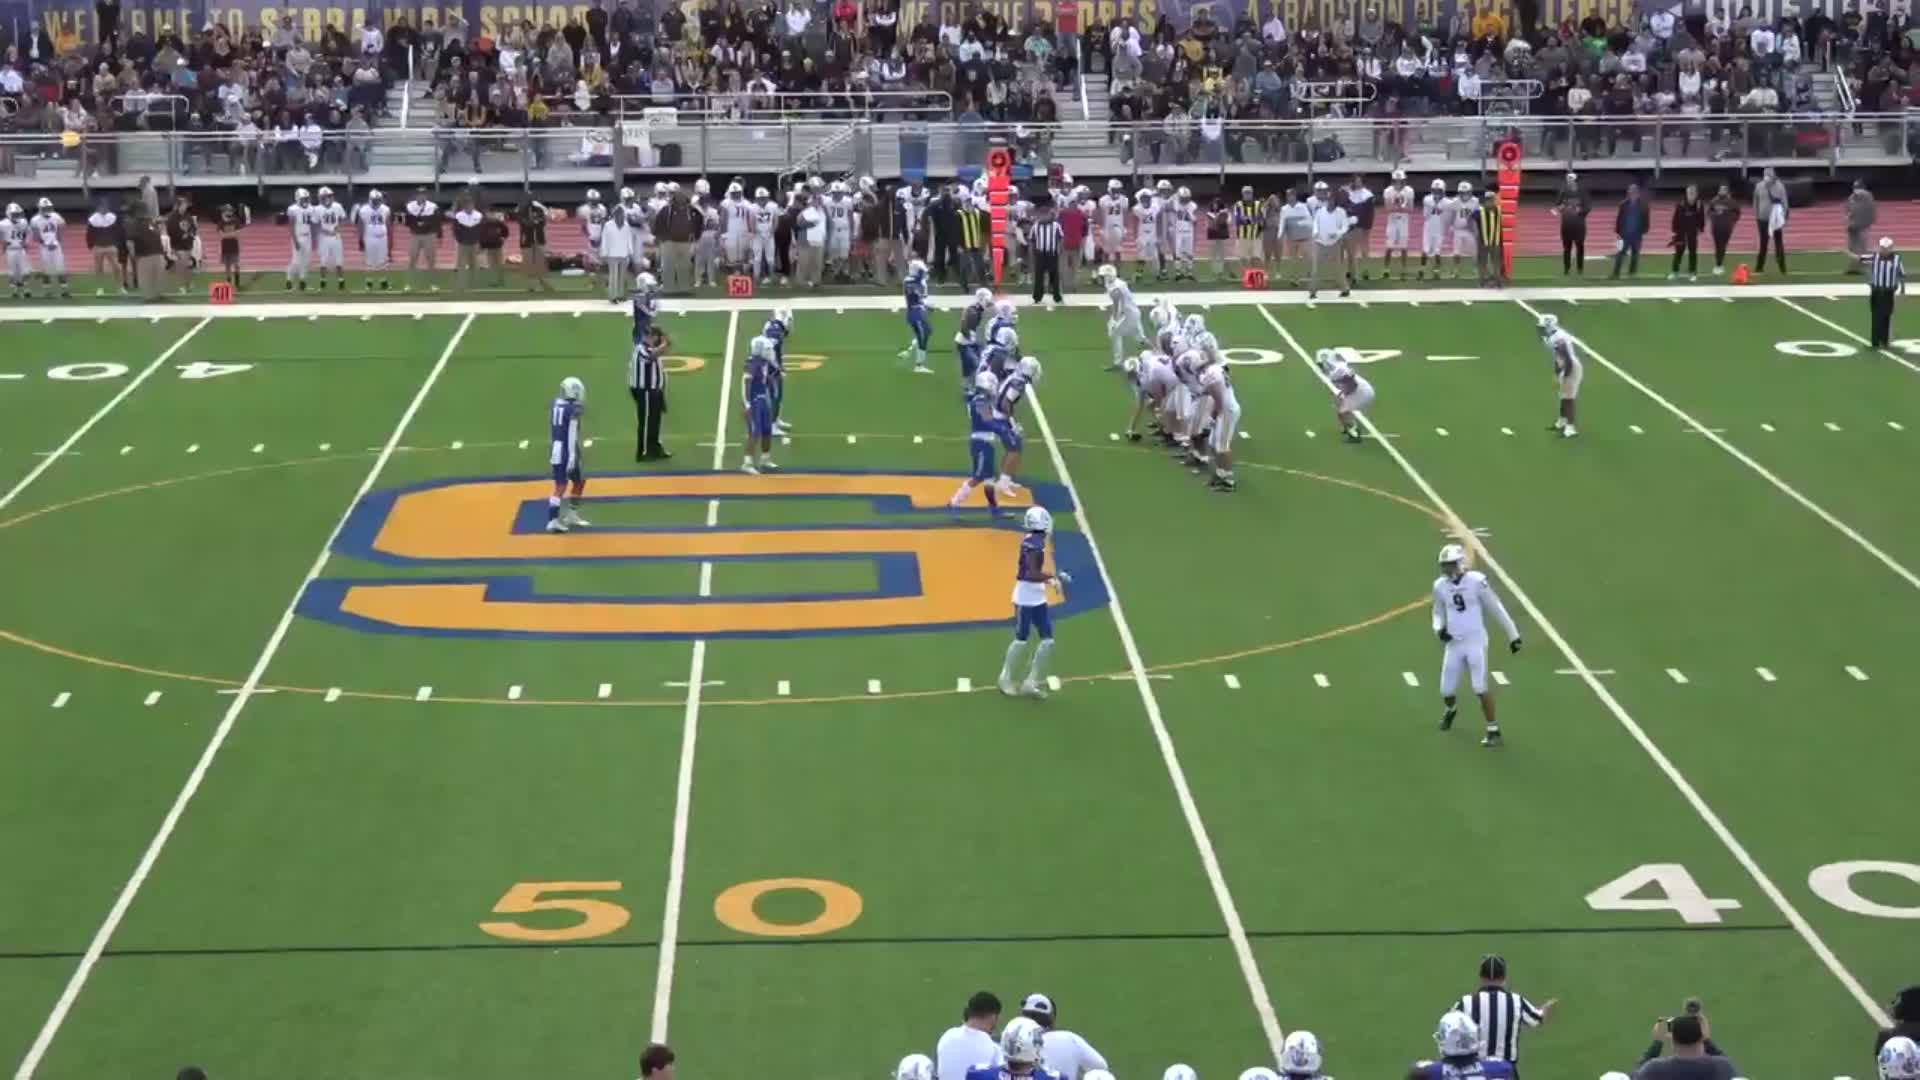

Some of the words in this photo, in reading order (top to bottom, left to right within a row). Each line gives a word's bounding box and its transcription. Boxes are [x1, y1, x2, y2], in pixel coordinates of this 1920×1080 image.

[43, 8, 193, 46] WELOME
[480, 6, 592, 40] SCHOO
[1035, 1, 1157, 34] PDRES
[732, 279, 749, 294] 50
[553, 407, 564, 426] 11
[1453, 593, 1466, 612] 9
